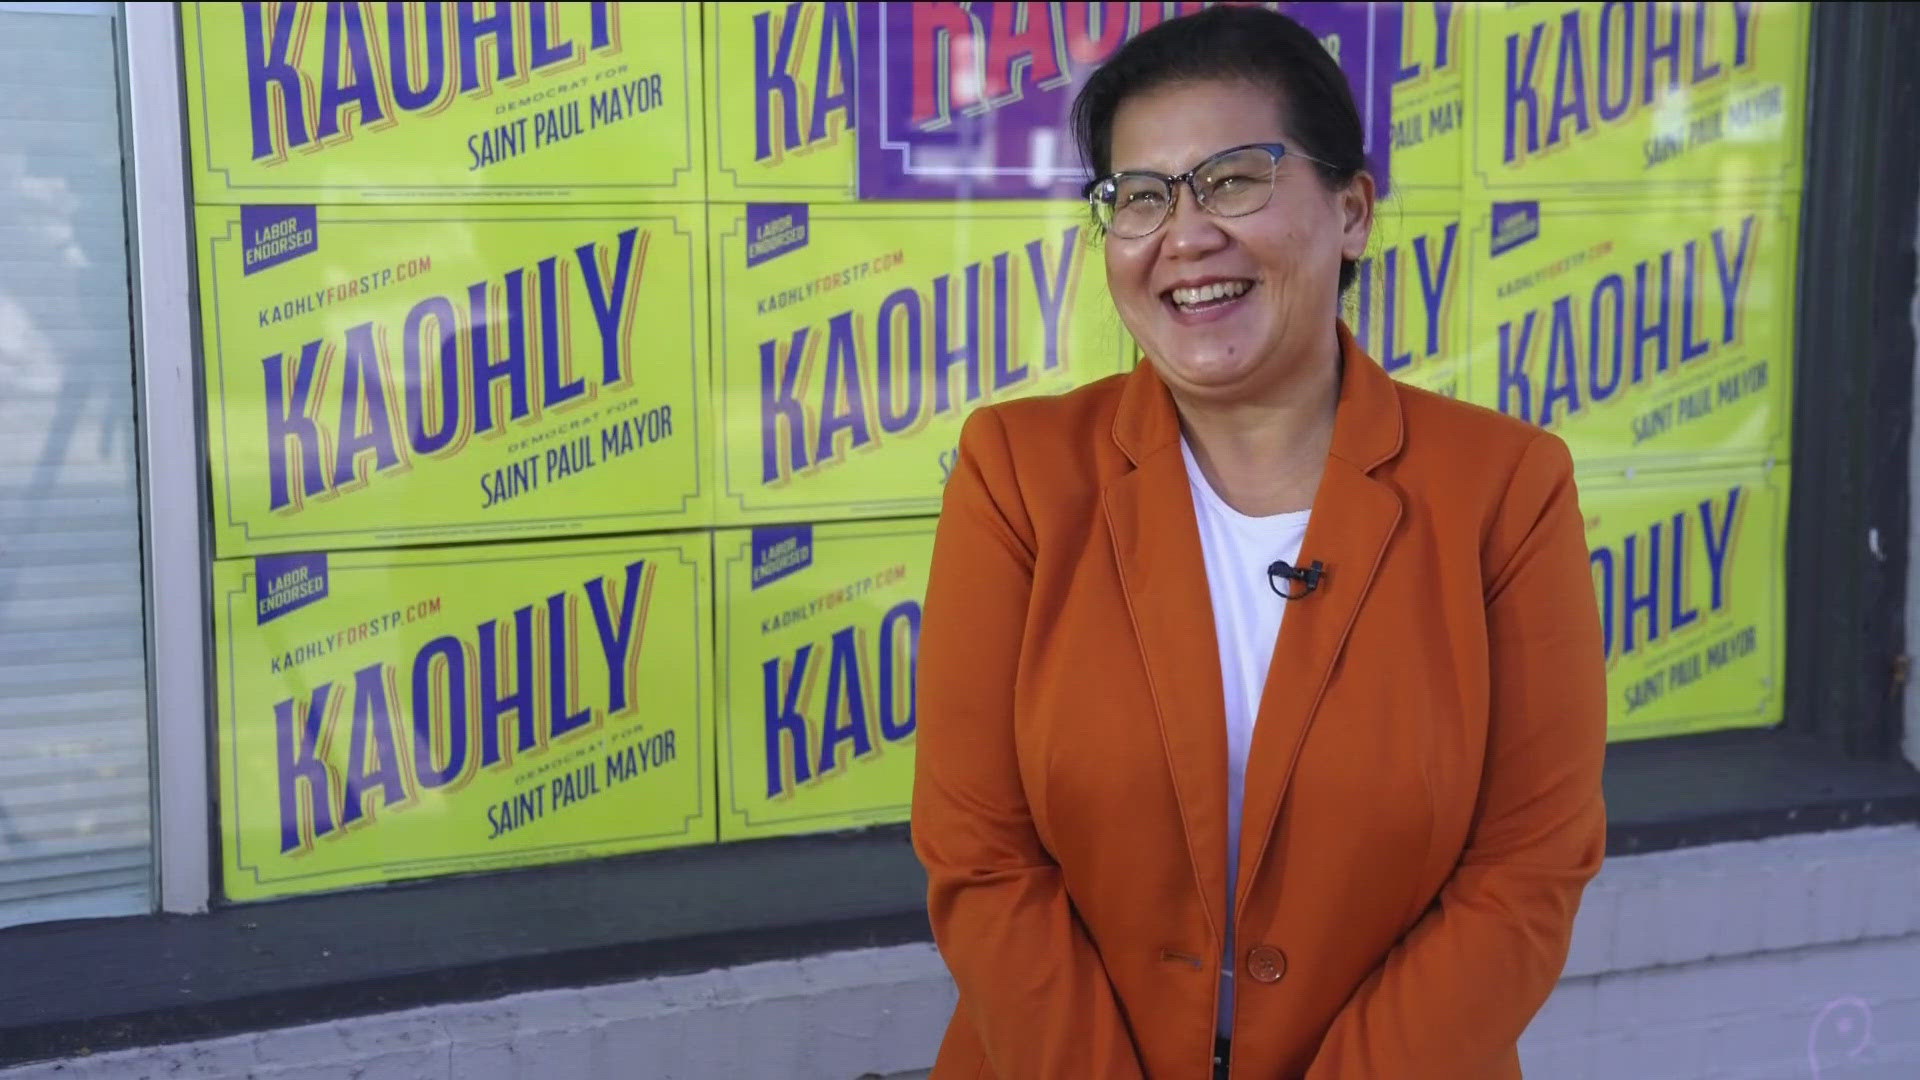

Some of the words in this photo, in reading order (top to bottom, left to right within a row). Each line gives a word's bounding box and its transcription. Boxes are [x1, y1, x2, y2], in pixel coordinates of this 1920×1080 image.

[467, 118, 527, 171] SAINT
[534, 100, 584, 149] PAUL
[590, 73, 663, 129] MAYOR
[495, 77, 588, 115] DEMOCRAT
[595, 65, 628, 81] FOR
[246, 228, 313, 265] ENDORSED
[255, 217, 297, 245] LABOR
[258, 255, 432, 328] KAOHLYFORSTP.COM
[1498, 214, 1757, 428] KAOHLY
[262, 226, 646, 513] KAOHLY
[759, 224, 1084, 486] KAOHLY
[607, 397, 639, 415] FOR
[480, 454, 540, 509] SAINT
[546, 435, 596, 483] PAUL
[601, 405, 672, 462] MAYOR
[259, 576, 324, 615] ENDORSED
[268, 566, 309, 595] LABOR
[1590, 485, 1743, 662] OHLY
[271, 596, 441, 674] KAOHLYFORSTP.COM
[273, 559, 652, 856] KAOHLY
[762, 600, 924, 800] KAO
[488, 784, 545, 840] SAINT
[552, 762, 600, 811] PAUL
[606, 729, 675, 788] MAYOR
